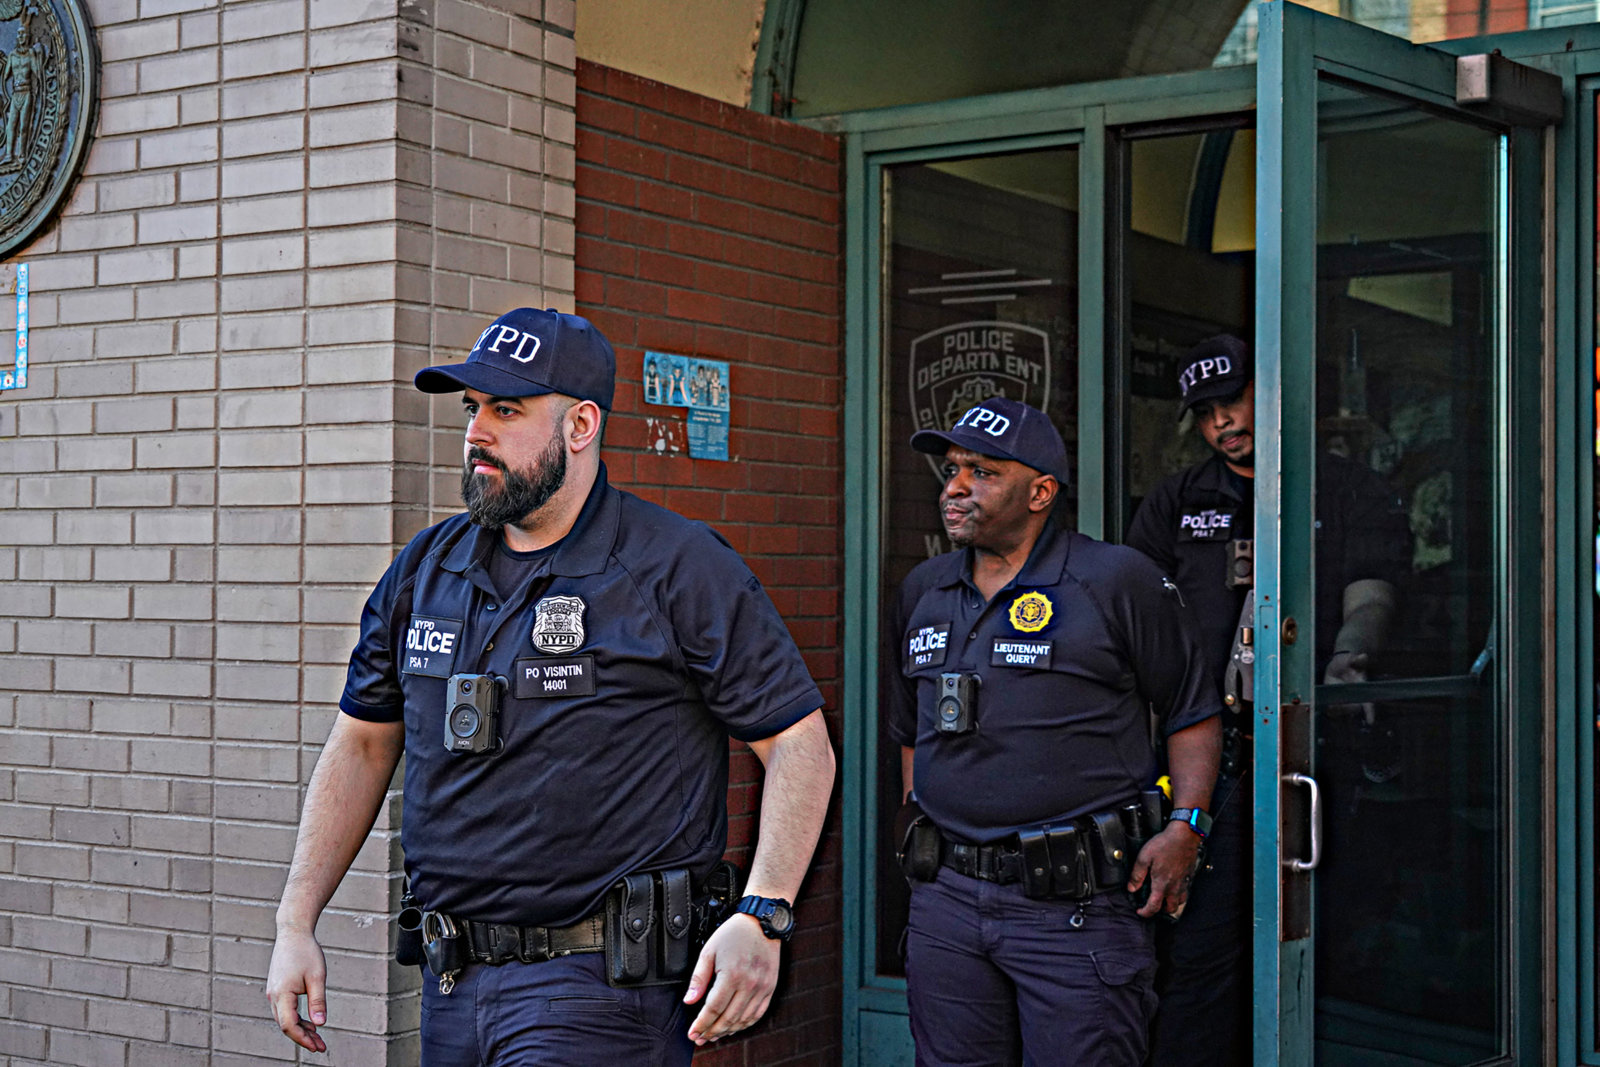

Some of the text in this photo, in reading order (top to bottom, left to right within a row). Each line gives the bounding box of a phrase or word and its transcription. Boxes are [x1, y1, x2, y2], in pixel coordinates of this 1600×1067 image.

[467, 324, 542, 364] YPD
[943, 329, 1015, 356] POLICE
[952, 406, 1010, 437] YPD
[1180, 514, 1232, 529] POLICE
[414, 619, 435, 631] NYPD
[541, 634, 576, 645] NYPD
[909, 631, 948, 656] POLICE
[993, 642, 1051, 656] LIEUTENANT
[408, 656, 430, 669] PSA 7
[915, 653, 933, 665] PSA 7
[1005, 653, 1037, 665] QUERY
[525, 664, 583, 680] PO VISINTIN
[542, 679, 567, 692] 14001
